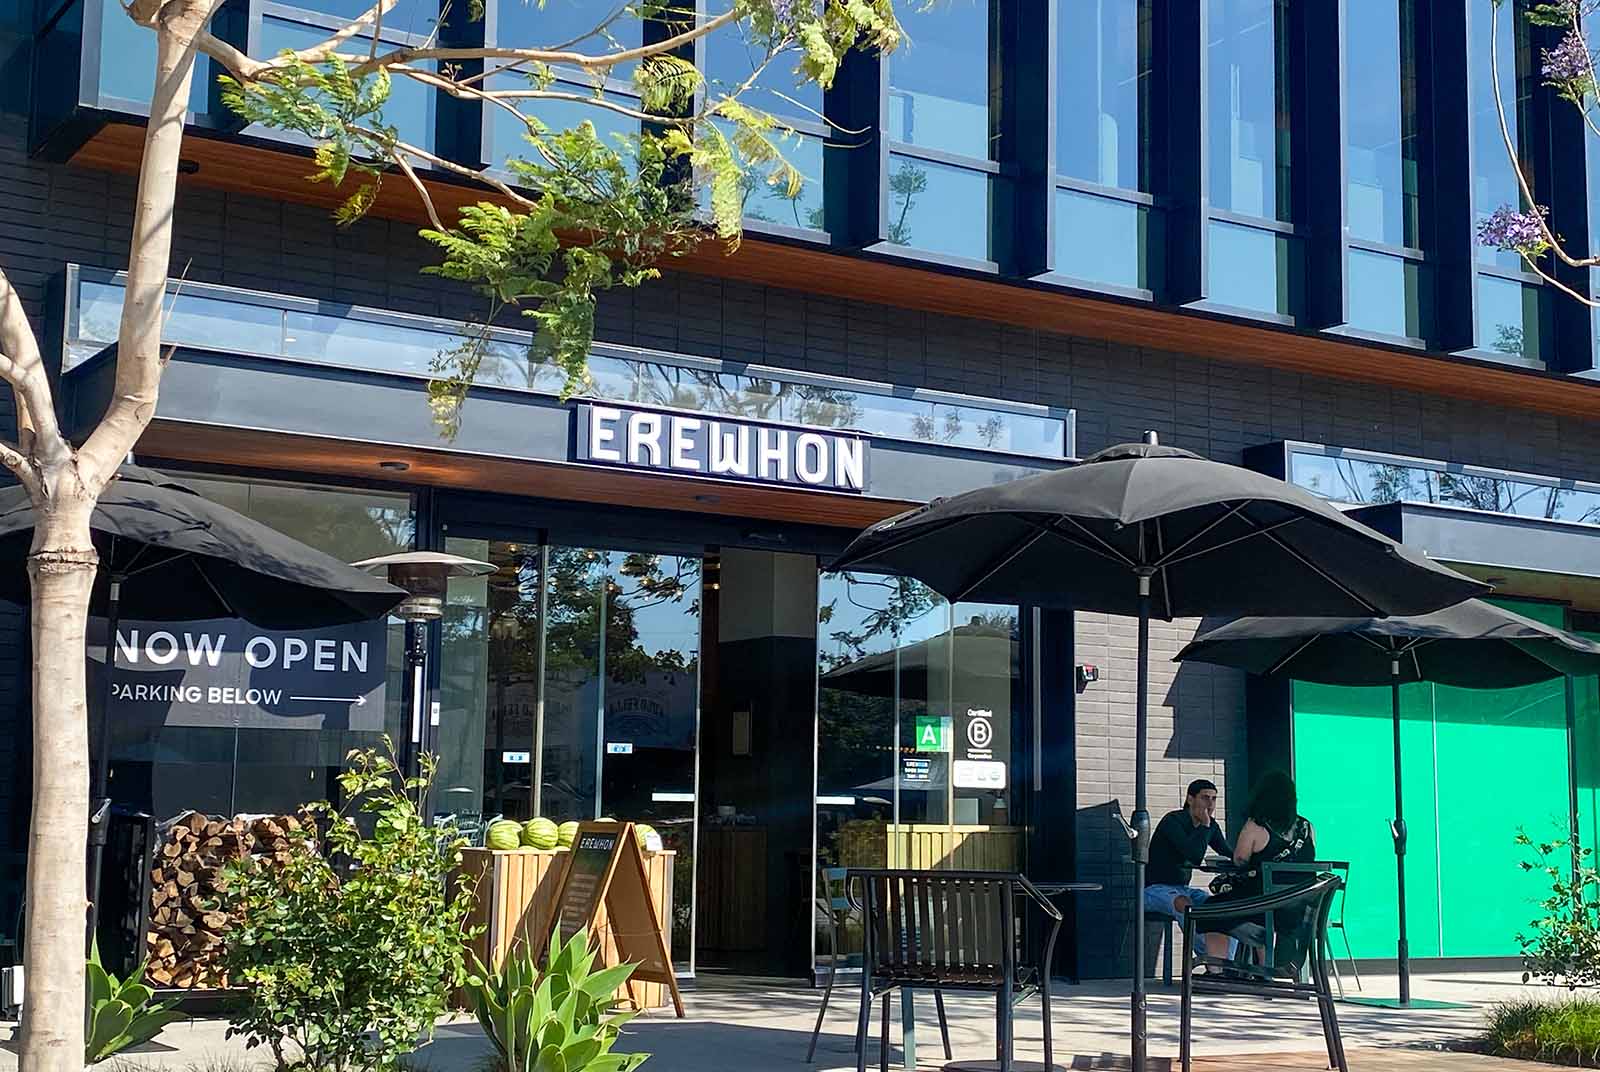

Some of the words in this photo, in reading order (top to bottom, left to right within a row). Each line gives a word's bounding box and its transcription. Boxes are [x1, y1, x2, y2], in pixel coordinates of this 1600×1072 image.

[589, 406, 864, 489] EREWHON
[114, 629, 226, 667] NOW
[245, 636, 368, 673] OPEN
[207, 686, 283, 706] BELOW
[921, 724, 937, 745] A
[580, 837, 615, 850] EREWHON
